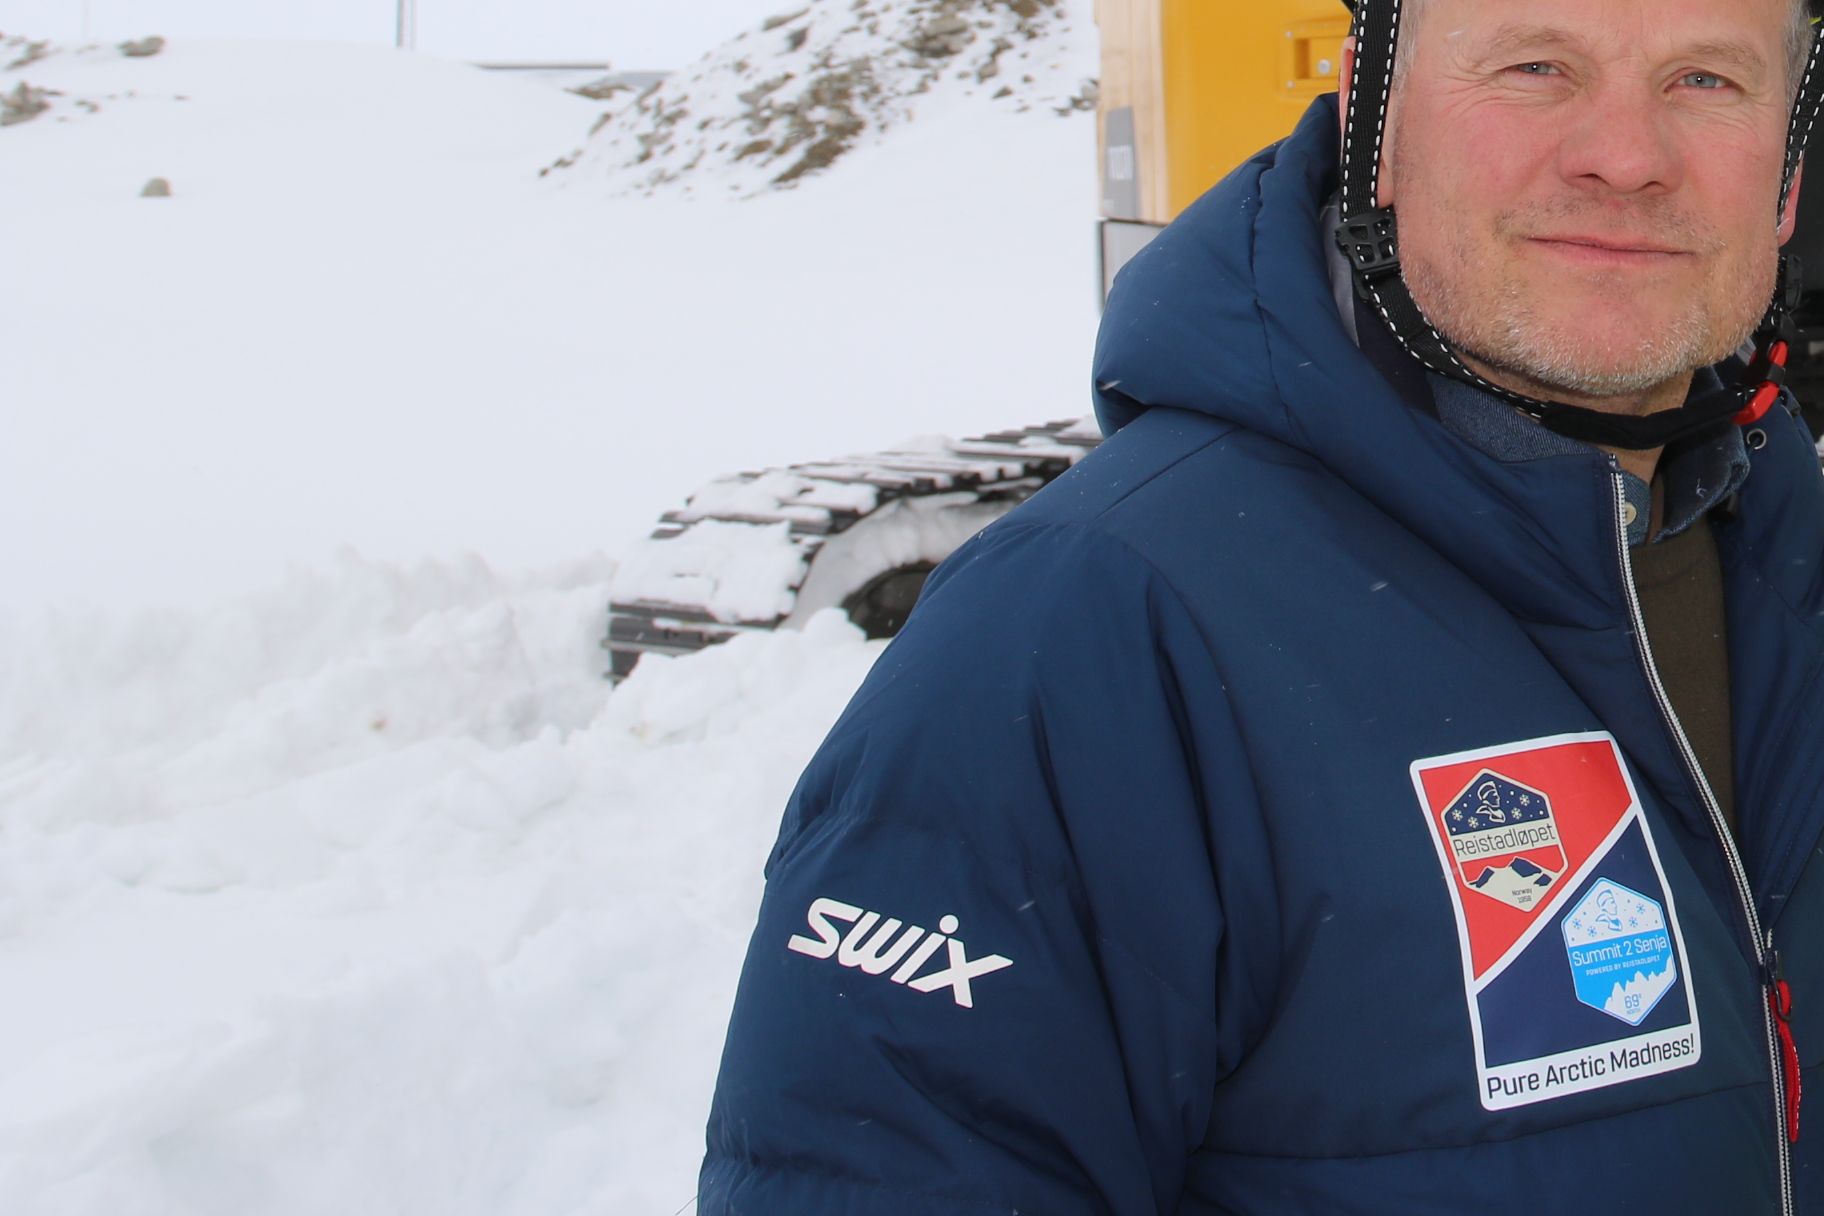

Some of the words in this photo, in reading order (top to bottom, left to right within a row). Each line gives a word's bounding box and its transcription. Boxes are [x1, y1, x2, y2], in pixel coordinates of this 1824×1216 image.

[1452, 822, 1556, 858] Reistadløpet
[1572, 943, 1622, 967] Summit
[1623, 940, 1633, 956] 2
[1633, 935, 1668, 954] Senja
[1486, 1072, 1540, 1100] Pure
[1545, 1055, 1606, 1088] Arctic
[1609, 1033, 1695, 1073] Madness!
